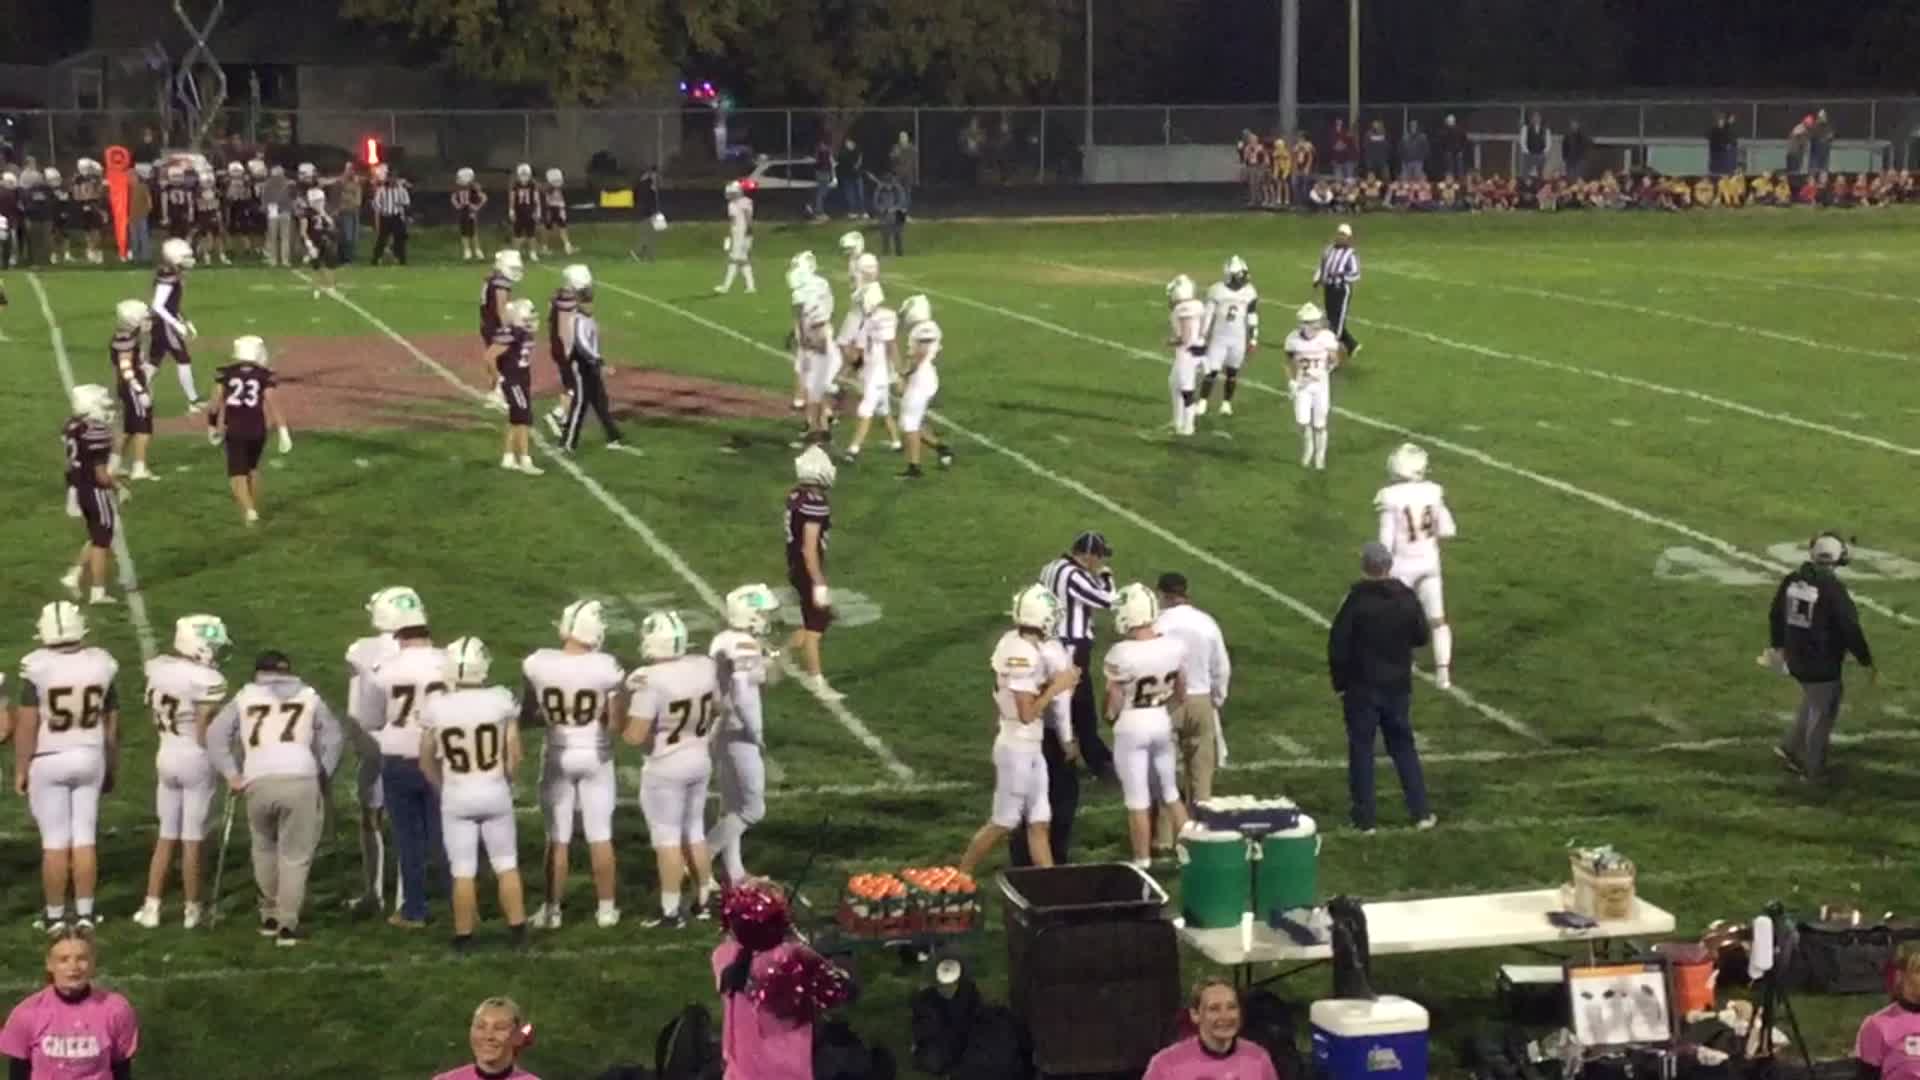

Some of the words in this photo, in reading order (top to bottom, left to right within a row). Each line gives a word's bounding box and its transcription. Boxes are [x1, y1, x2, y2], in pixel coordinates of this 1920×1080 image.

[1226, 304, 1240, 322] 6
[226, 377, 261, 407] 23
[1403, 503, 1438, 542] 14
[246, 703, 304, 746] 77
[543, 686, 598, 727] 88
[667, 691, 714, 745] 70
[440, 723, 499, 774] 60
